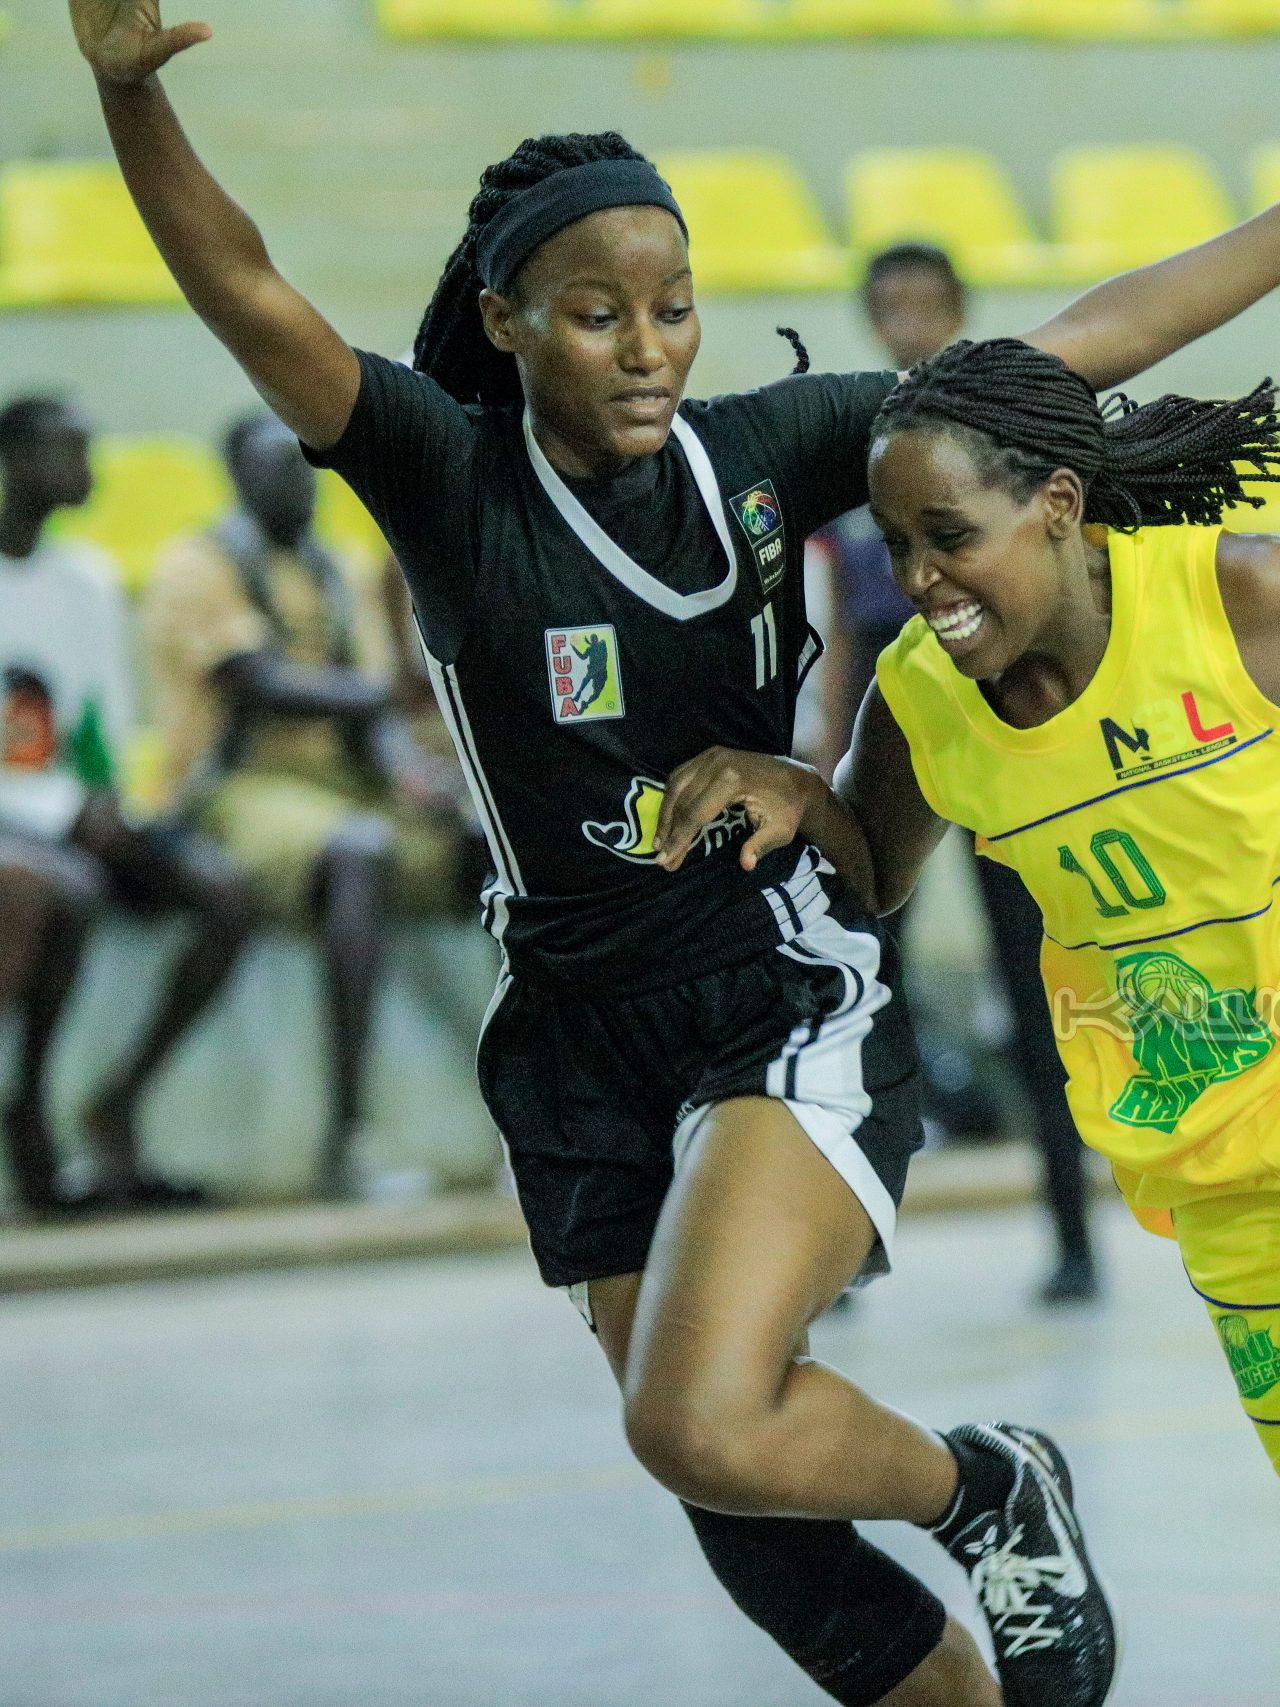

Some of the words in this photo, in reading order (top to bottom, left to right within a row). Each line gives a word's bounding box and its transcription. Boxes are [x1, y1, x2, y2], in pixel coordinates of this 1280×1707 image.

[759, 538, 782, 566] FIBA
[551, 634, 580, 717] FUBA
[751, 602, 777, 690] 11
[1120, 763, 1152, 779] NATIONAL
[1153, 750, 1200, 769] BASKETBALL
[1057, 828, 1166, 918] 10
